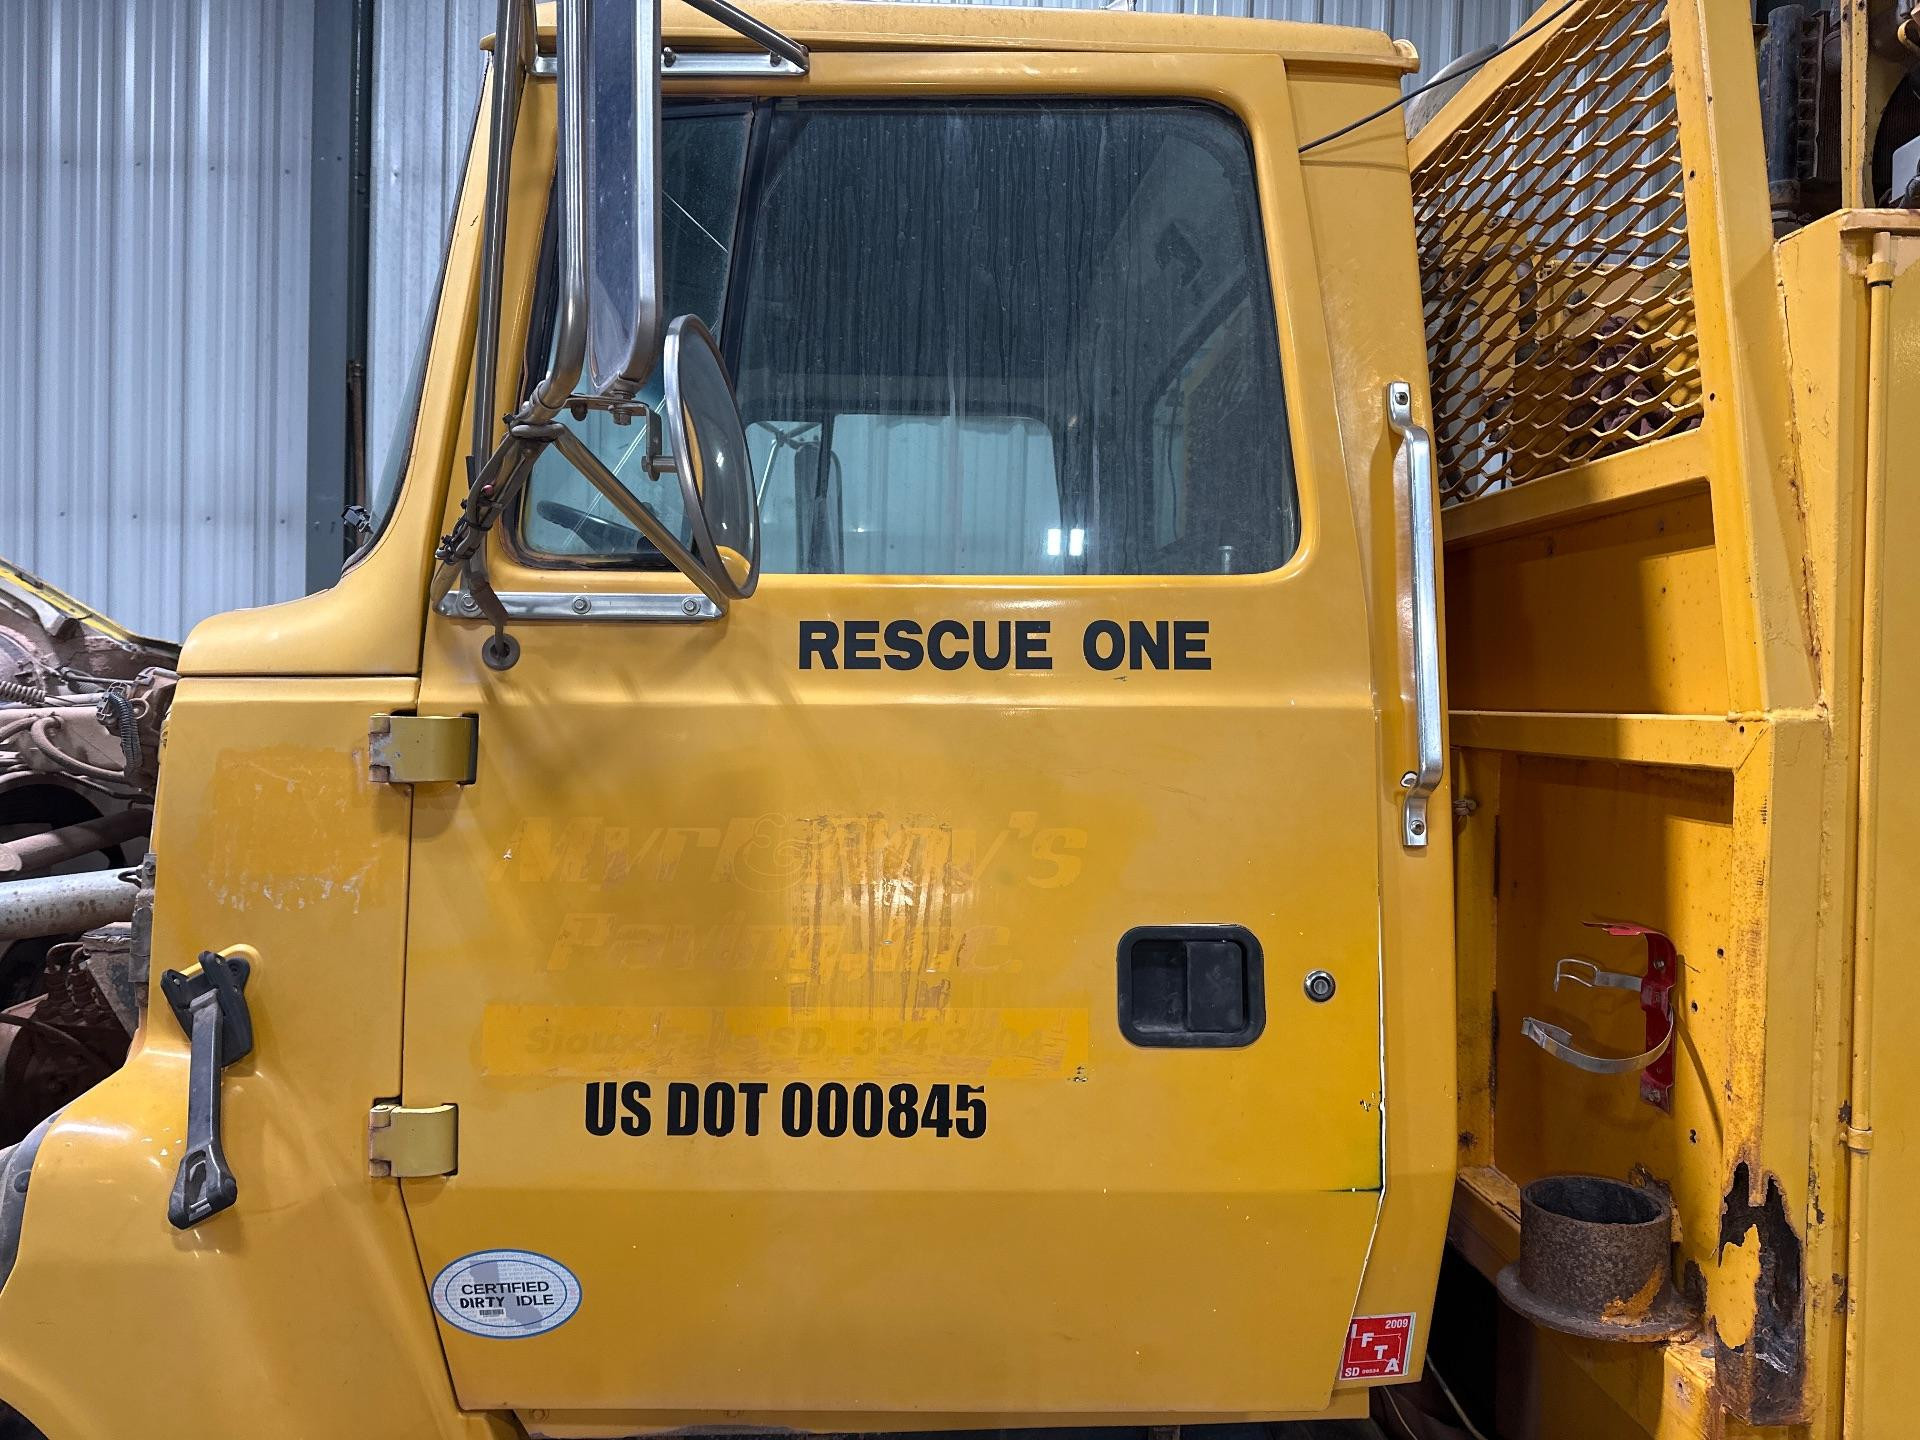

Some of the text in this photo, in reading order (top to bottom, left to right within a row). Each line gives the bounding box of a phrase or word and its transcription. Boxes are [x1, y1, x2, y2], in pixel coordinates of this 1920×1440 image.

[798, 619, 1212, 671] RESCUE ONE
[584, 1081, 987, 1139] US DOT 000845
[461, 1281, 549, 1295] CERTIFIED
[460, 1295, 554, 1309] DIRTY IDLE
[1385, 1318, 1409, 1329] 2009
[1344, 1367, 1360, 1377] SD
